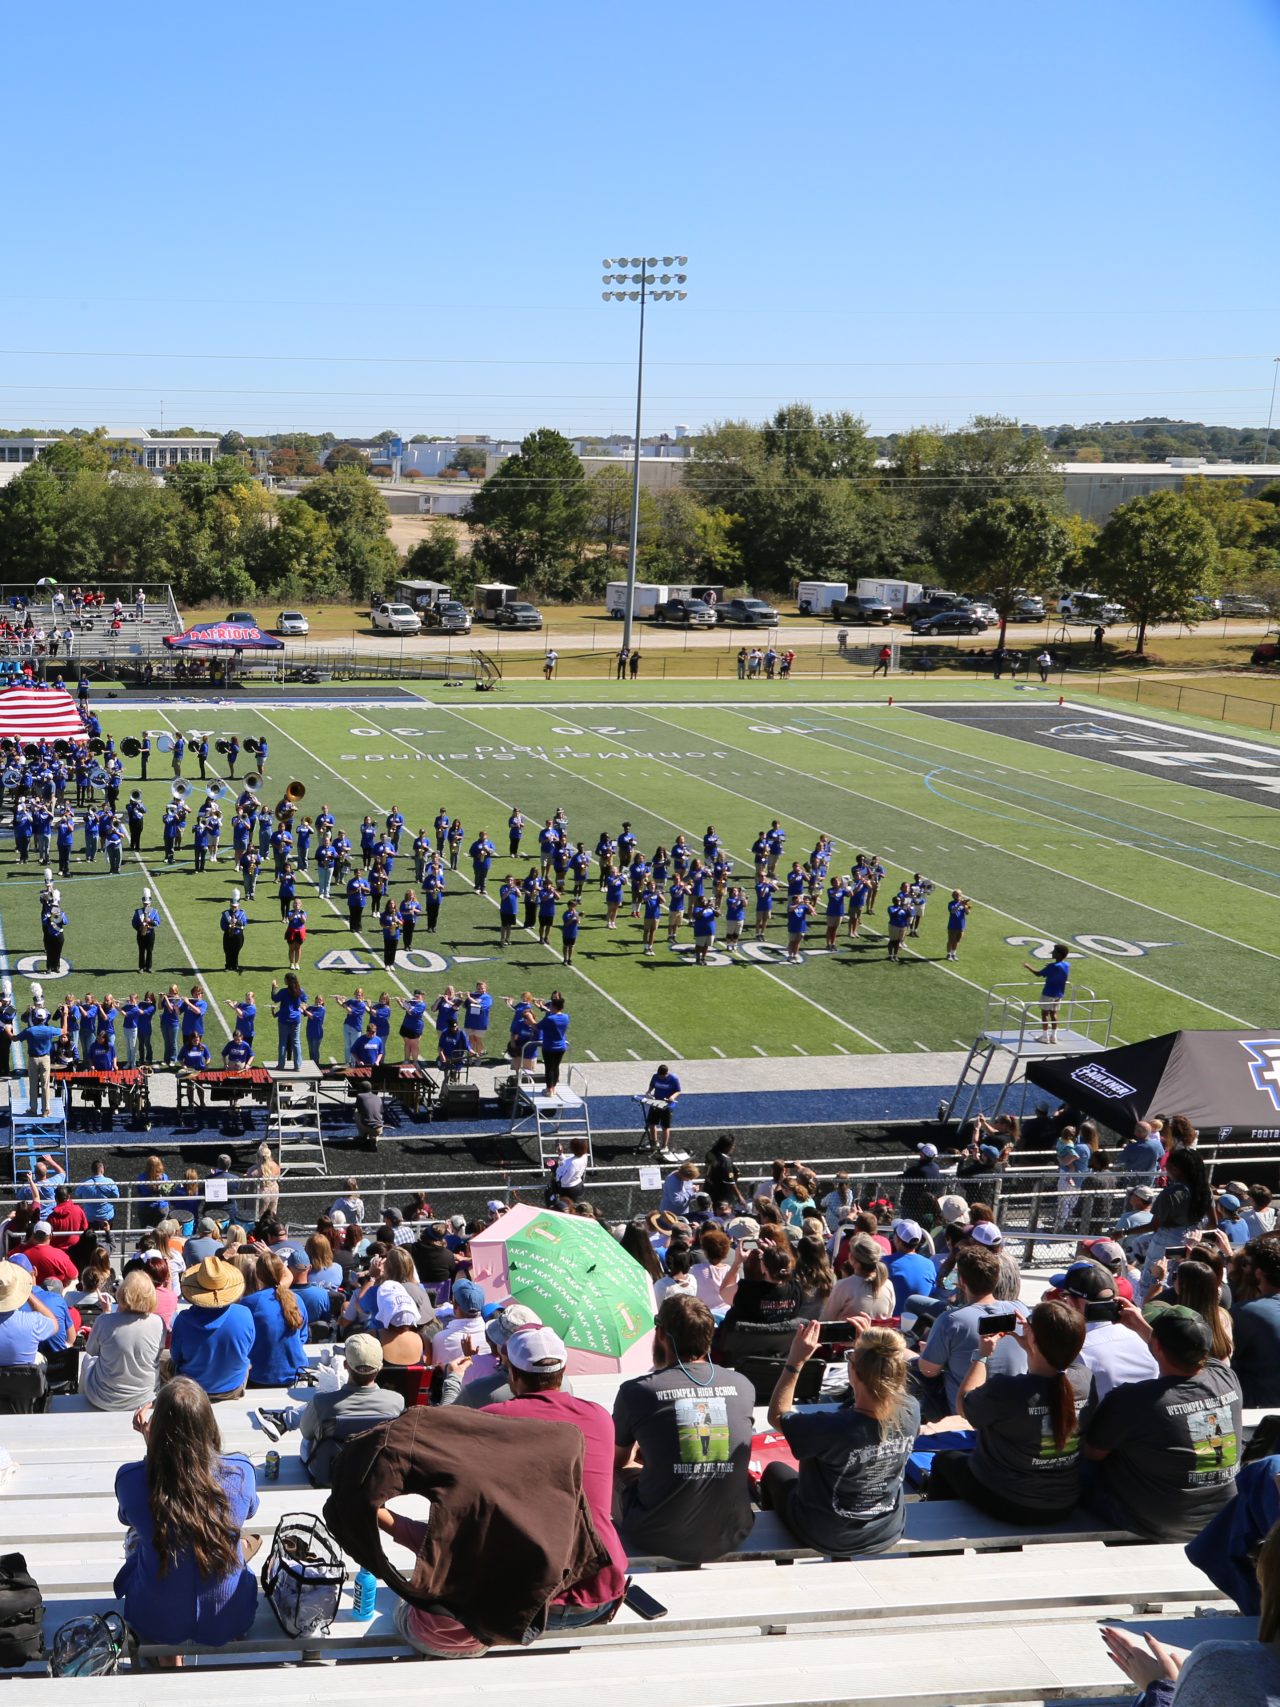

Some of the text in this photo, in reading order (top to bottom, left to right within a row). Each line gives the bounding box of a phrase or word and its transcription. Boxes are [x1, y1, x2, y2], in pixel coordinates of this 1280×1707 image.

[190, 628, 261, 640] PATRIOTS
[349, 727, 426, 737] 30
[474, 745, 572, 755] Field
[340, 752, 517, 762] Stallings
[1005, 934, 1147, 959] 20
[316, 947, 450, 975] 40
[1078, 1067, 1131, 1096] FAULKNER
[656, 1386, 738, 1400] WETUMPKA HIGH SCHOOL
[1166, 1390, 1239, 1416] WETUMPKA HIGH SCHOOL
[673, 1463, 734, 1473] PRIDE OF THE TRIBE
[1188, 1473, 1207, 1482] PRIDE
[1208, 1471, 1217, 1479] OF
